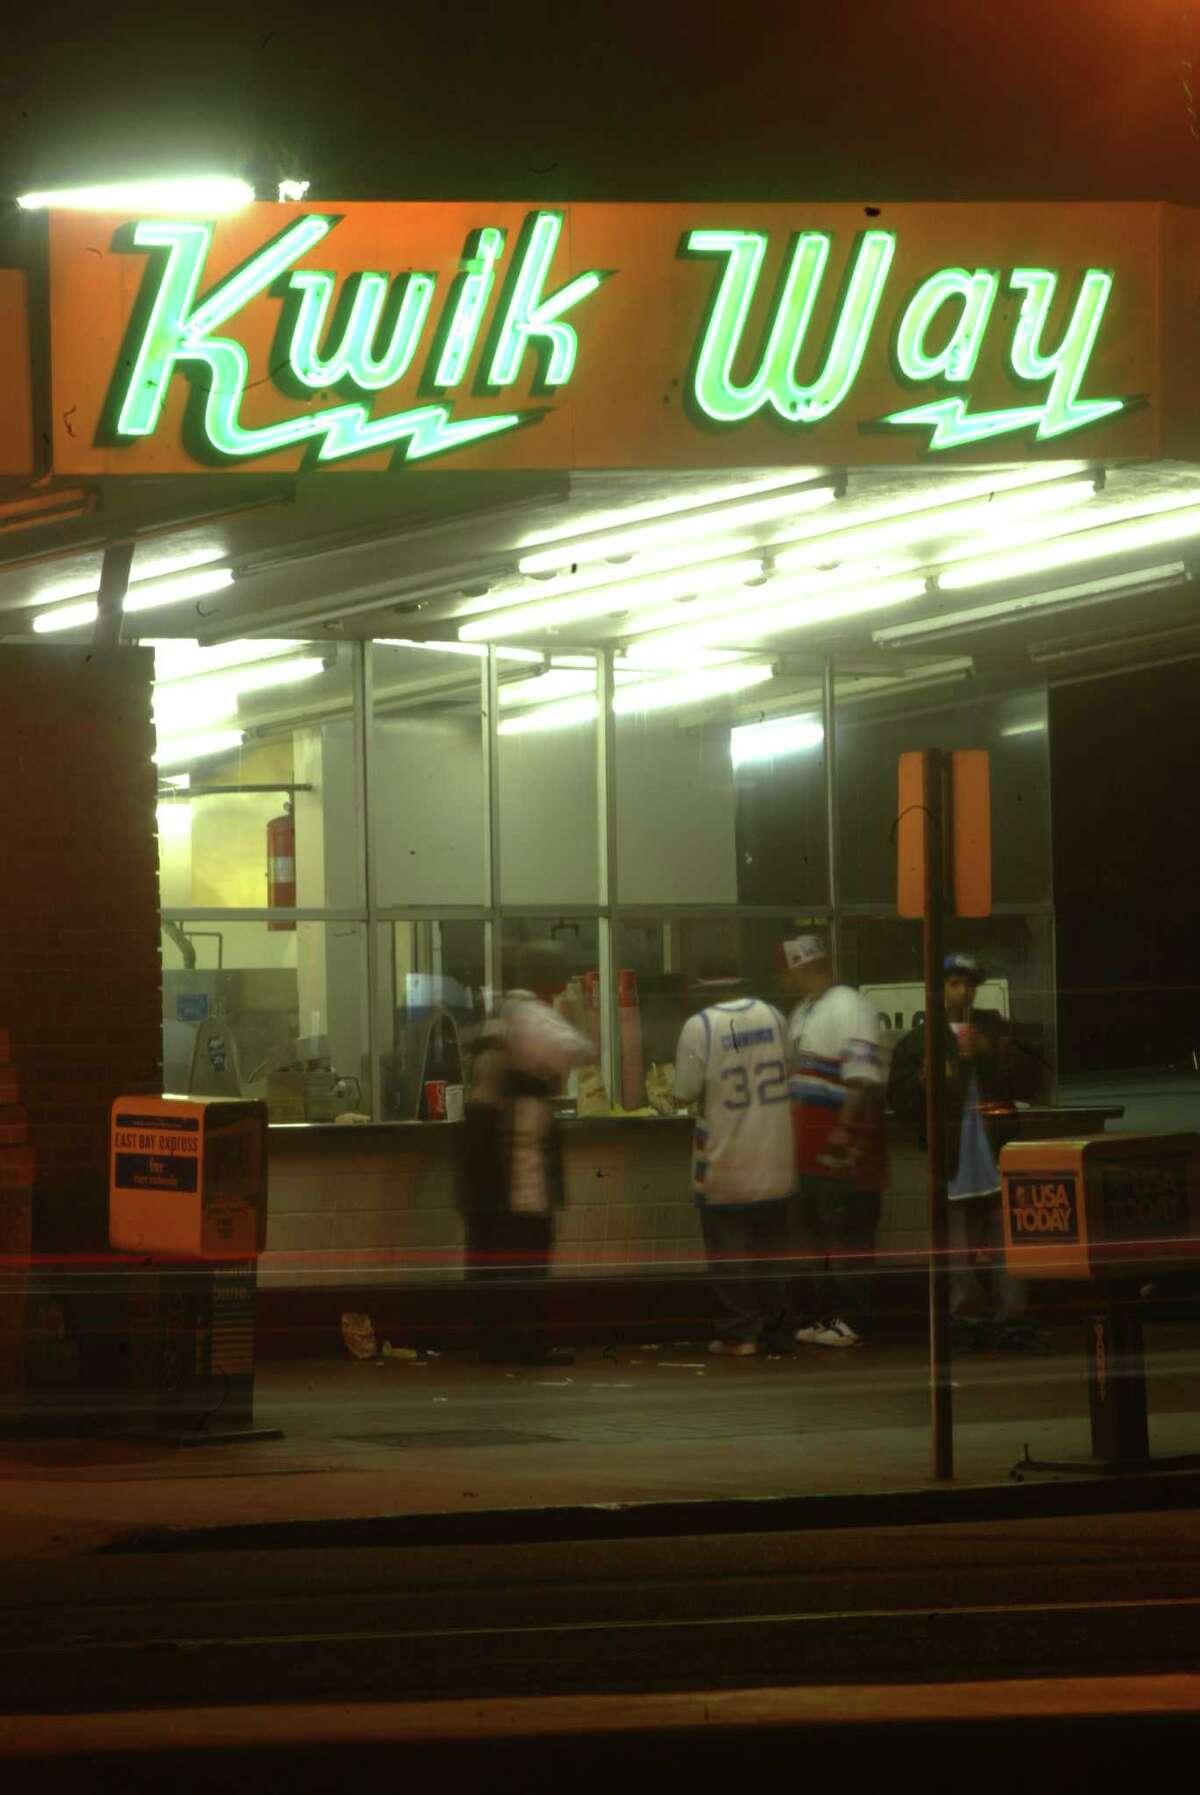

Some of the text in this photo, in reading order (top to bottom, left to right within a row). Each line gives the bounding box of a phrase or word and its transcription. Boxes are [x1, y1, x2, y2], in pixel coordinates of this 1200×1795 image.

[112, 210, 1124, 459] Kwik Way
[720, 1059, 789, 1111] 32
[114, 1132, 137, 1149] EAST
[1031, 1183, 1070, 1209] USA
[1012, 1207, 1072, 1232] TODAY
